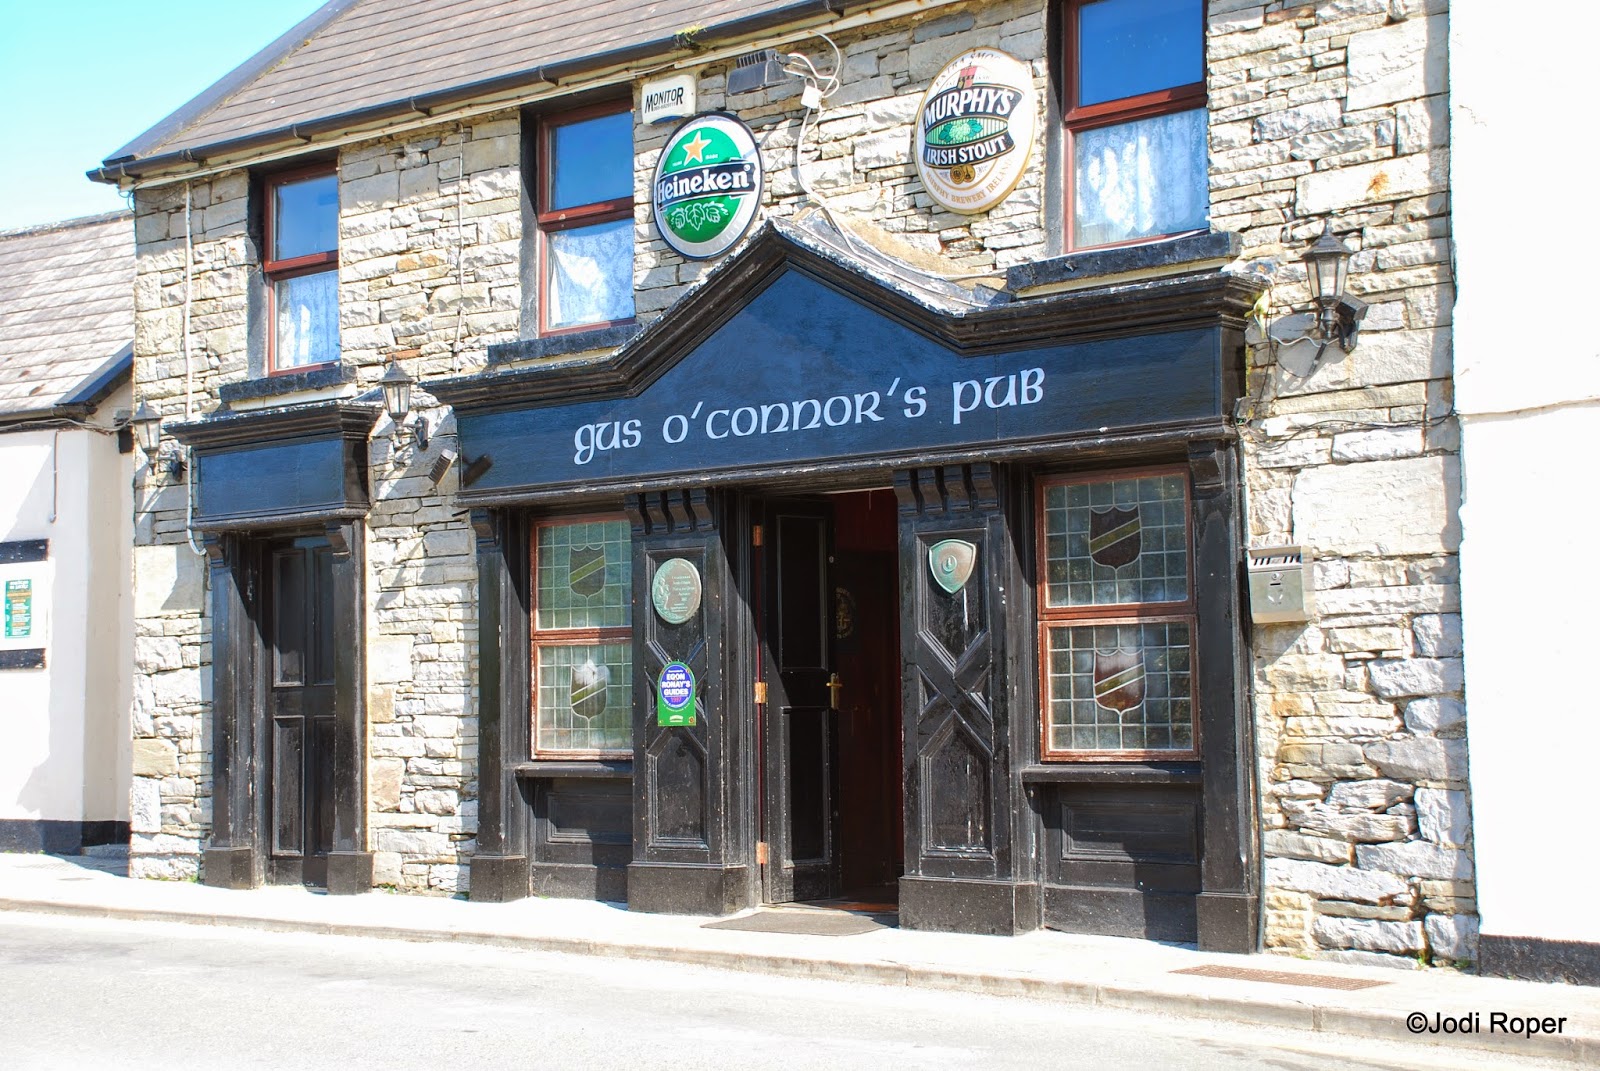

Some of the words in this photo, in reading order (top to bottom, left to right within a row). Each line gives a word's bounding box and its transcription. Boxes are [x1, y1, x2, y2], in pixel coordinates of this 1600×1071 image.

[645, 86, 684, 114] MONITOR
[927, 148, 958, 166] IRISH
[959, 136, 1007, 164] STOUT
[951, 189, 987, 204] BREWERY
[666, 672, 686, 681] EGON
[663, 688, 689, 696] GUIDES
